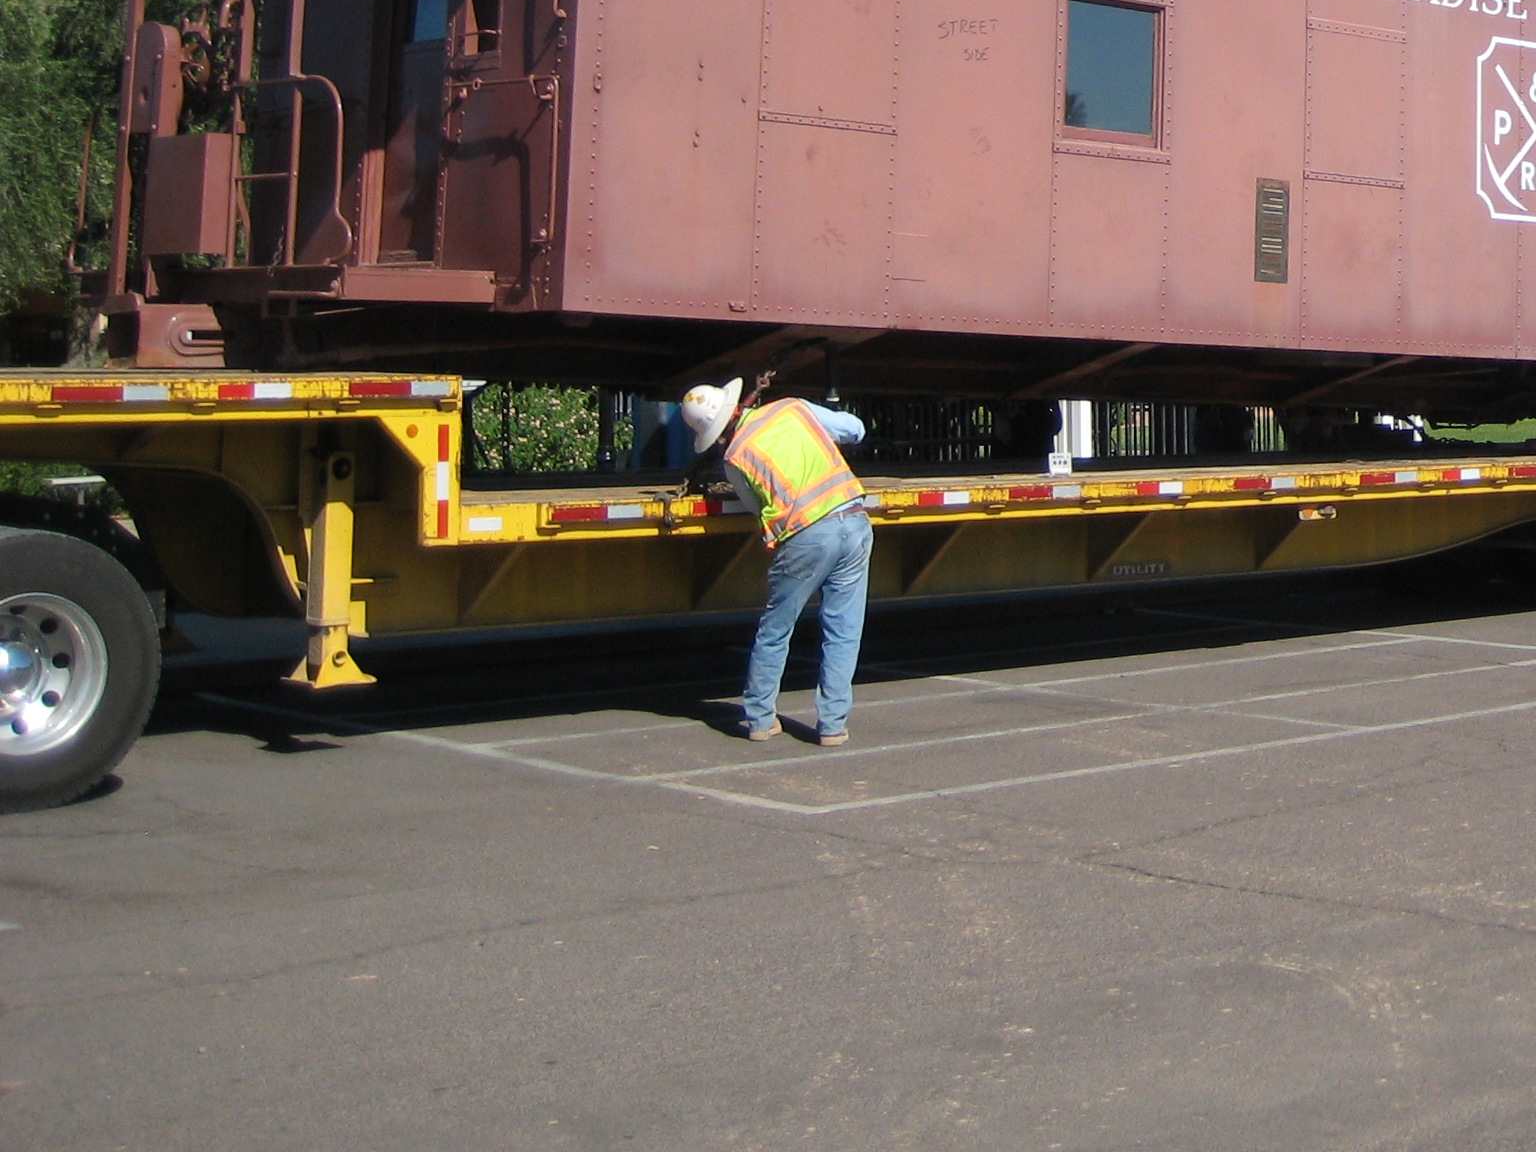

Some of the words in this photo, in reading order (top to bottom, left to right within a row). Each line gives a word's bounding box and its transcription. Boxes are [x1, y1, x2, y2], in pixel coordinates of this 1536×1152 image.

[938, 18, 998, 39] STREET
[963, 47, 990, 61] SIDE
[1494, 110, 1512, 145] P
[1113, 563, 1165, 575] UTILITY
